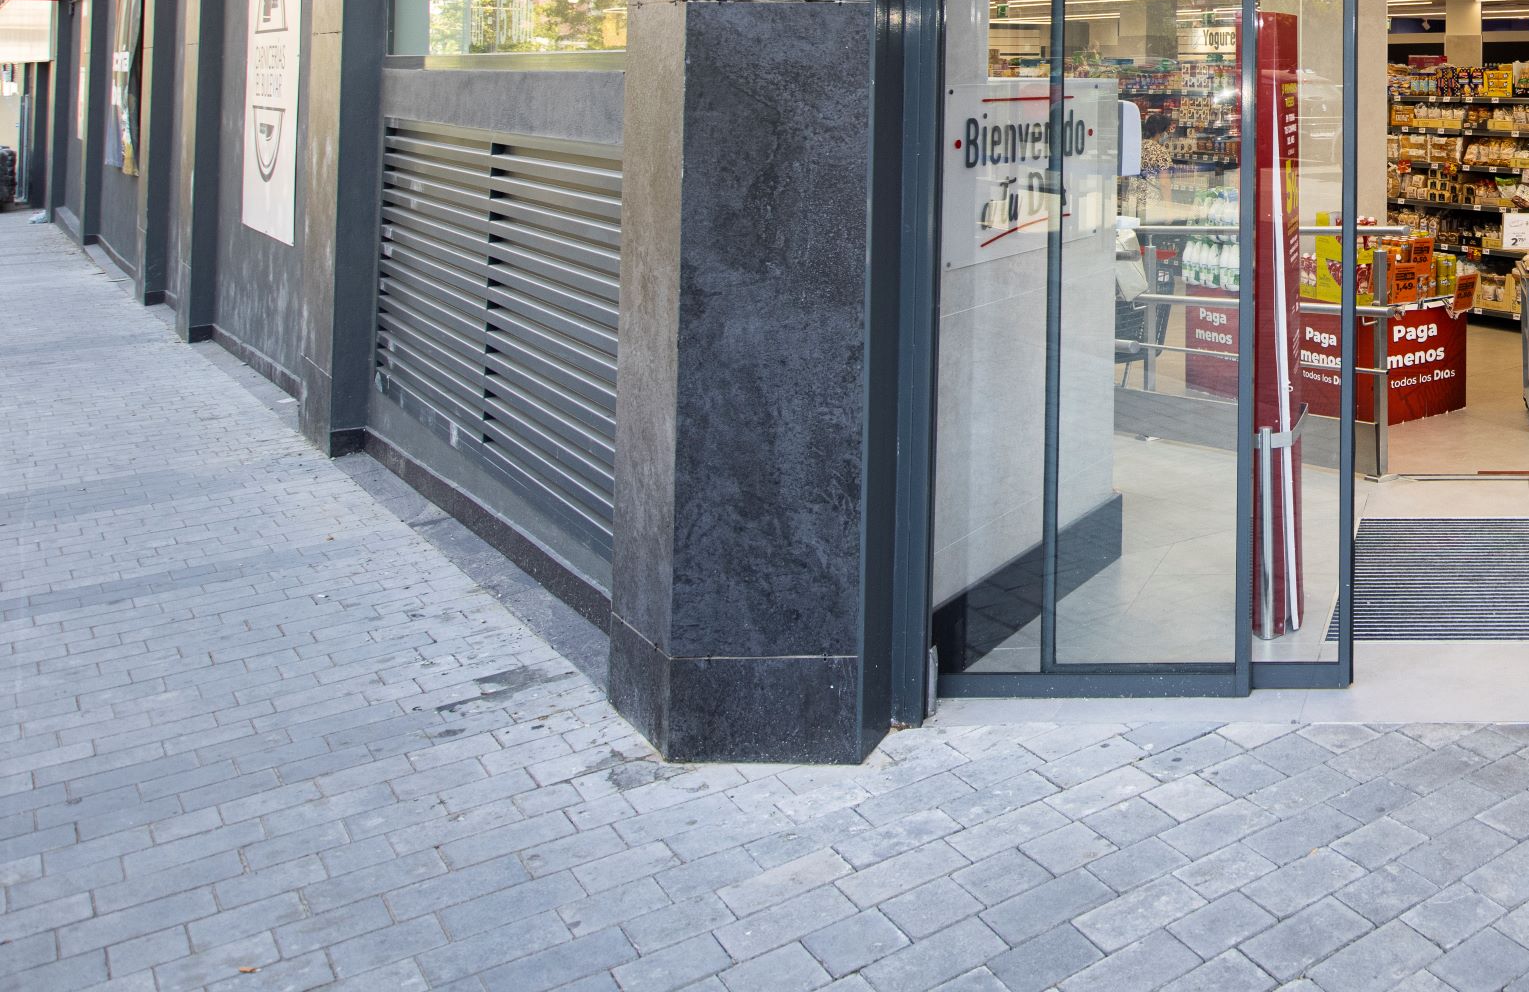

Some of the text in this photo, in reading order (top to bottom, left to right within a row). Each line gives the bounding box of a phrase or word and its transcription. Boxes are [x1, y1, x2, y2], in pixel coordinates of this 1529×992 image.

[1199, 307, 1227, 326] Paga
[1195, 328, 1233, 345] menos
[1305, 326, 1337, 348] Paga
[1393, 323, 1438, 343] Paga
[1300, 349, 1341, 368] menos
[1387, 346, 1445, 369] menos
[1302, 369, 1321, 382] todos
[1321, 374, 1333, 385] los
[1390, 368, 1456, 389] todos los Dias
